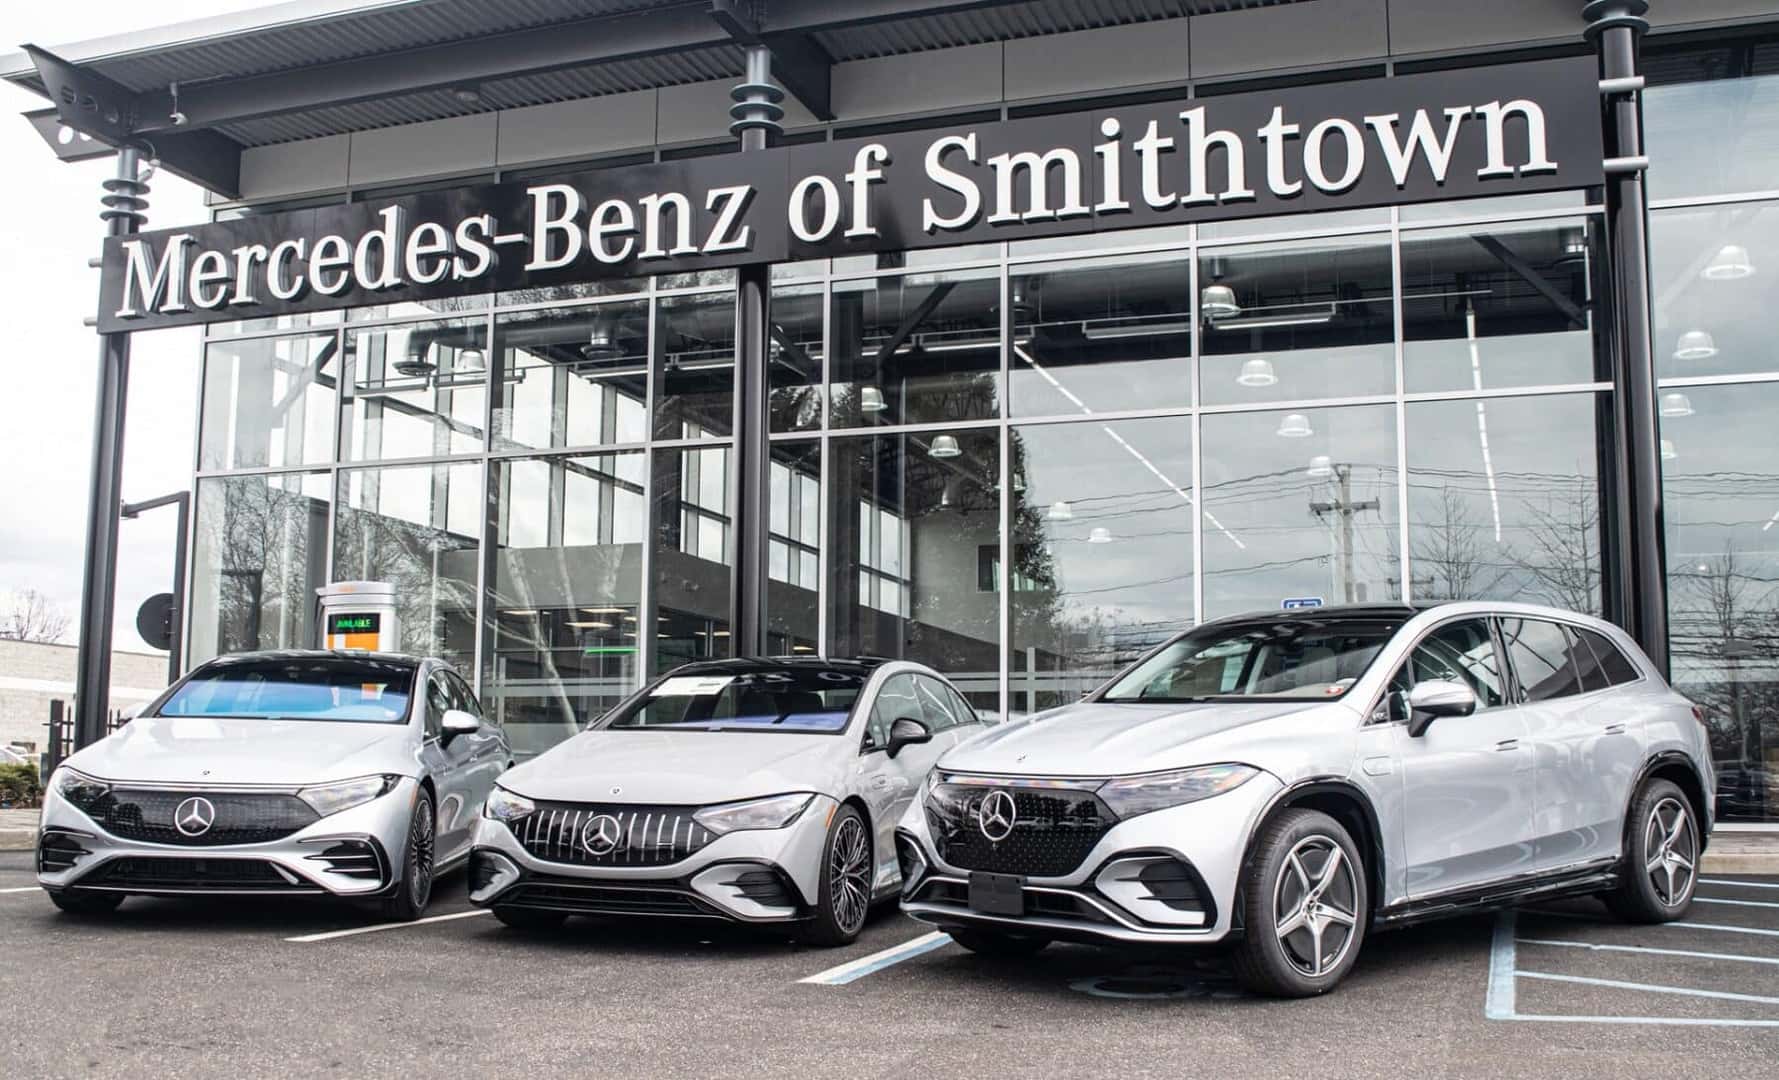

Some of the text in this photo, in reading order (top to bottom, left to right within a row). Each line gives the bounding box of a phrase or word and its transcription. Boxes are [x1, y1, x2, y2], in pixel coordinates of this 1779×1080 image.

[115, 98, 1558, 319] Mercedes-Benz of Smithtown
